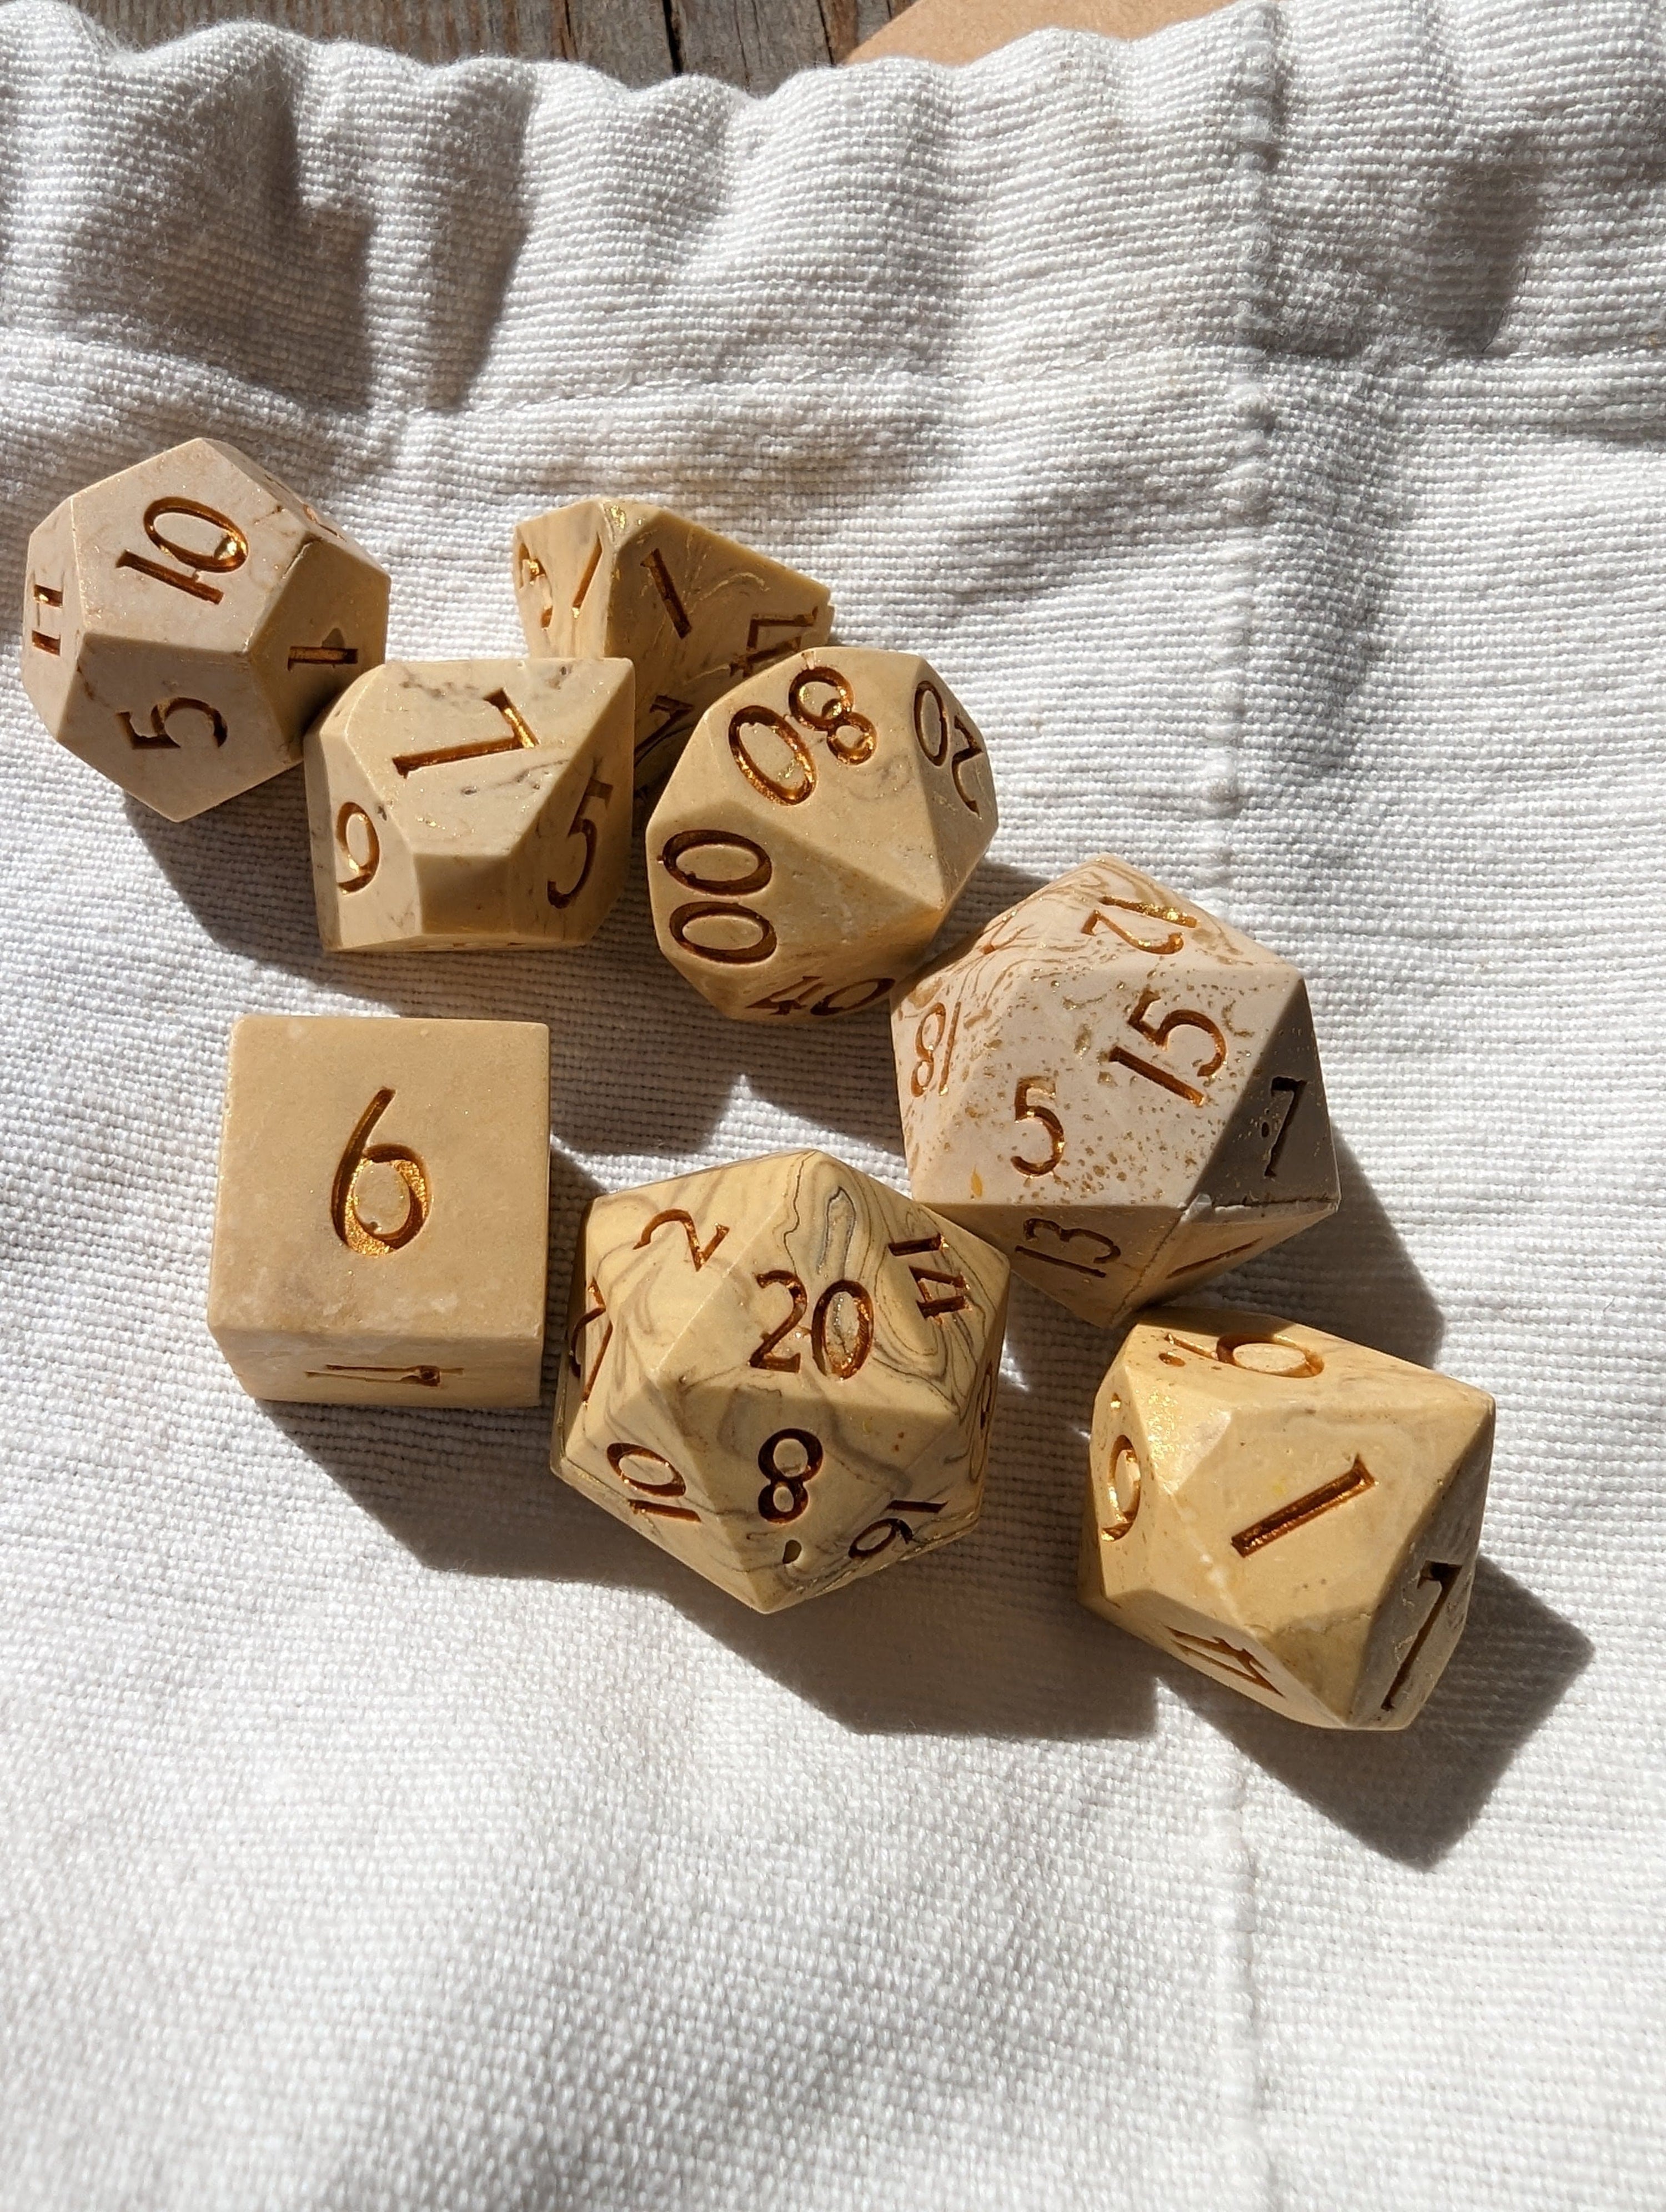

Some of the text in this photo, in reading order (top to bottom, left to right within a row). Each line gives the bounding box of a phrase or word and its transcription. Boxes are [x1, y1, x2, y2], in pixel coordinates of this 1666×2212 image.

[116, 496, 248, 605] 10
[640, 549, 693, 639] 1
[116, 697, 228, 750] 5
[392, 688, 539, 778] 7
[729, 666, 876, 806] 80
[914, 680, 985, 815] 20
[547, 776, 614, 909] 5
[662, 830, 777, 964] 00
[1082, 897, 1197, 955] 12
[745, 976, 895, 1016] 40
[911, 1001, 961, 1097] 18
[1109, 986, 1227, 1107] 15
[331, 1085, 433, 1256] 6
[1010, 1075, 1065, 1176] 5
[1263, 1076, 1307, 1177] 7
[633, 1208, 730, 1273] 2
[889, 1233, 972, 1325] 14
[1015, 1218, 1120, 1278] 13
[748, 1269, 874, 1380] 20
[606, 1442, 701, 1522] 10
[757, 1428, 823, 1524] 8
[1231, 1455, 1377, 1558] 1
[848, 1498, 950, 1558] 16
